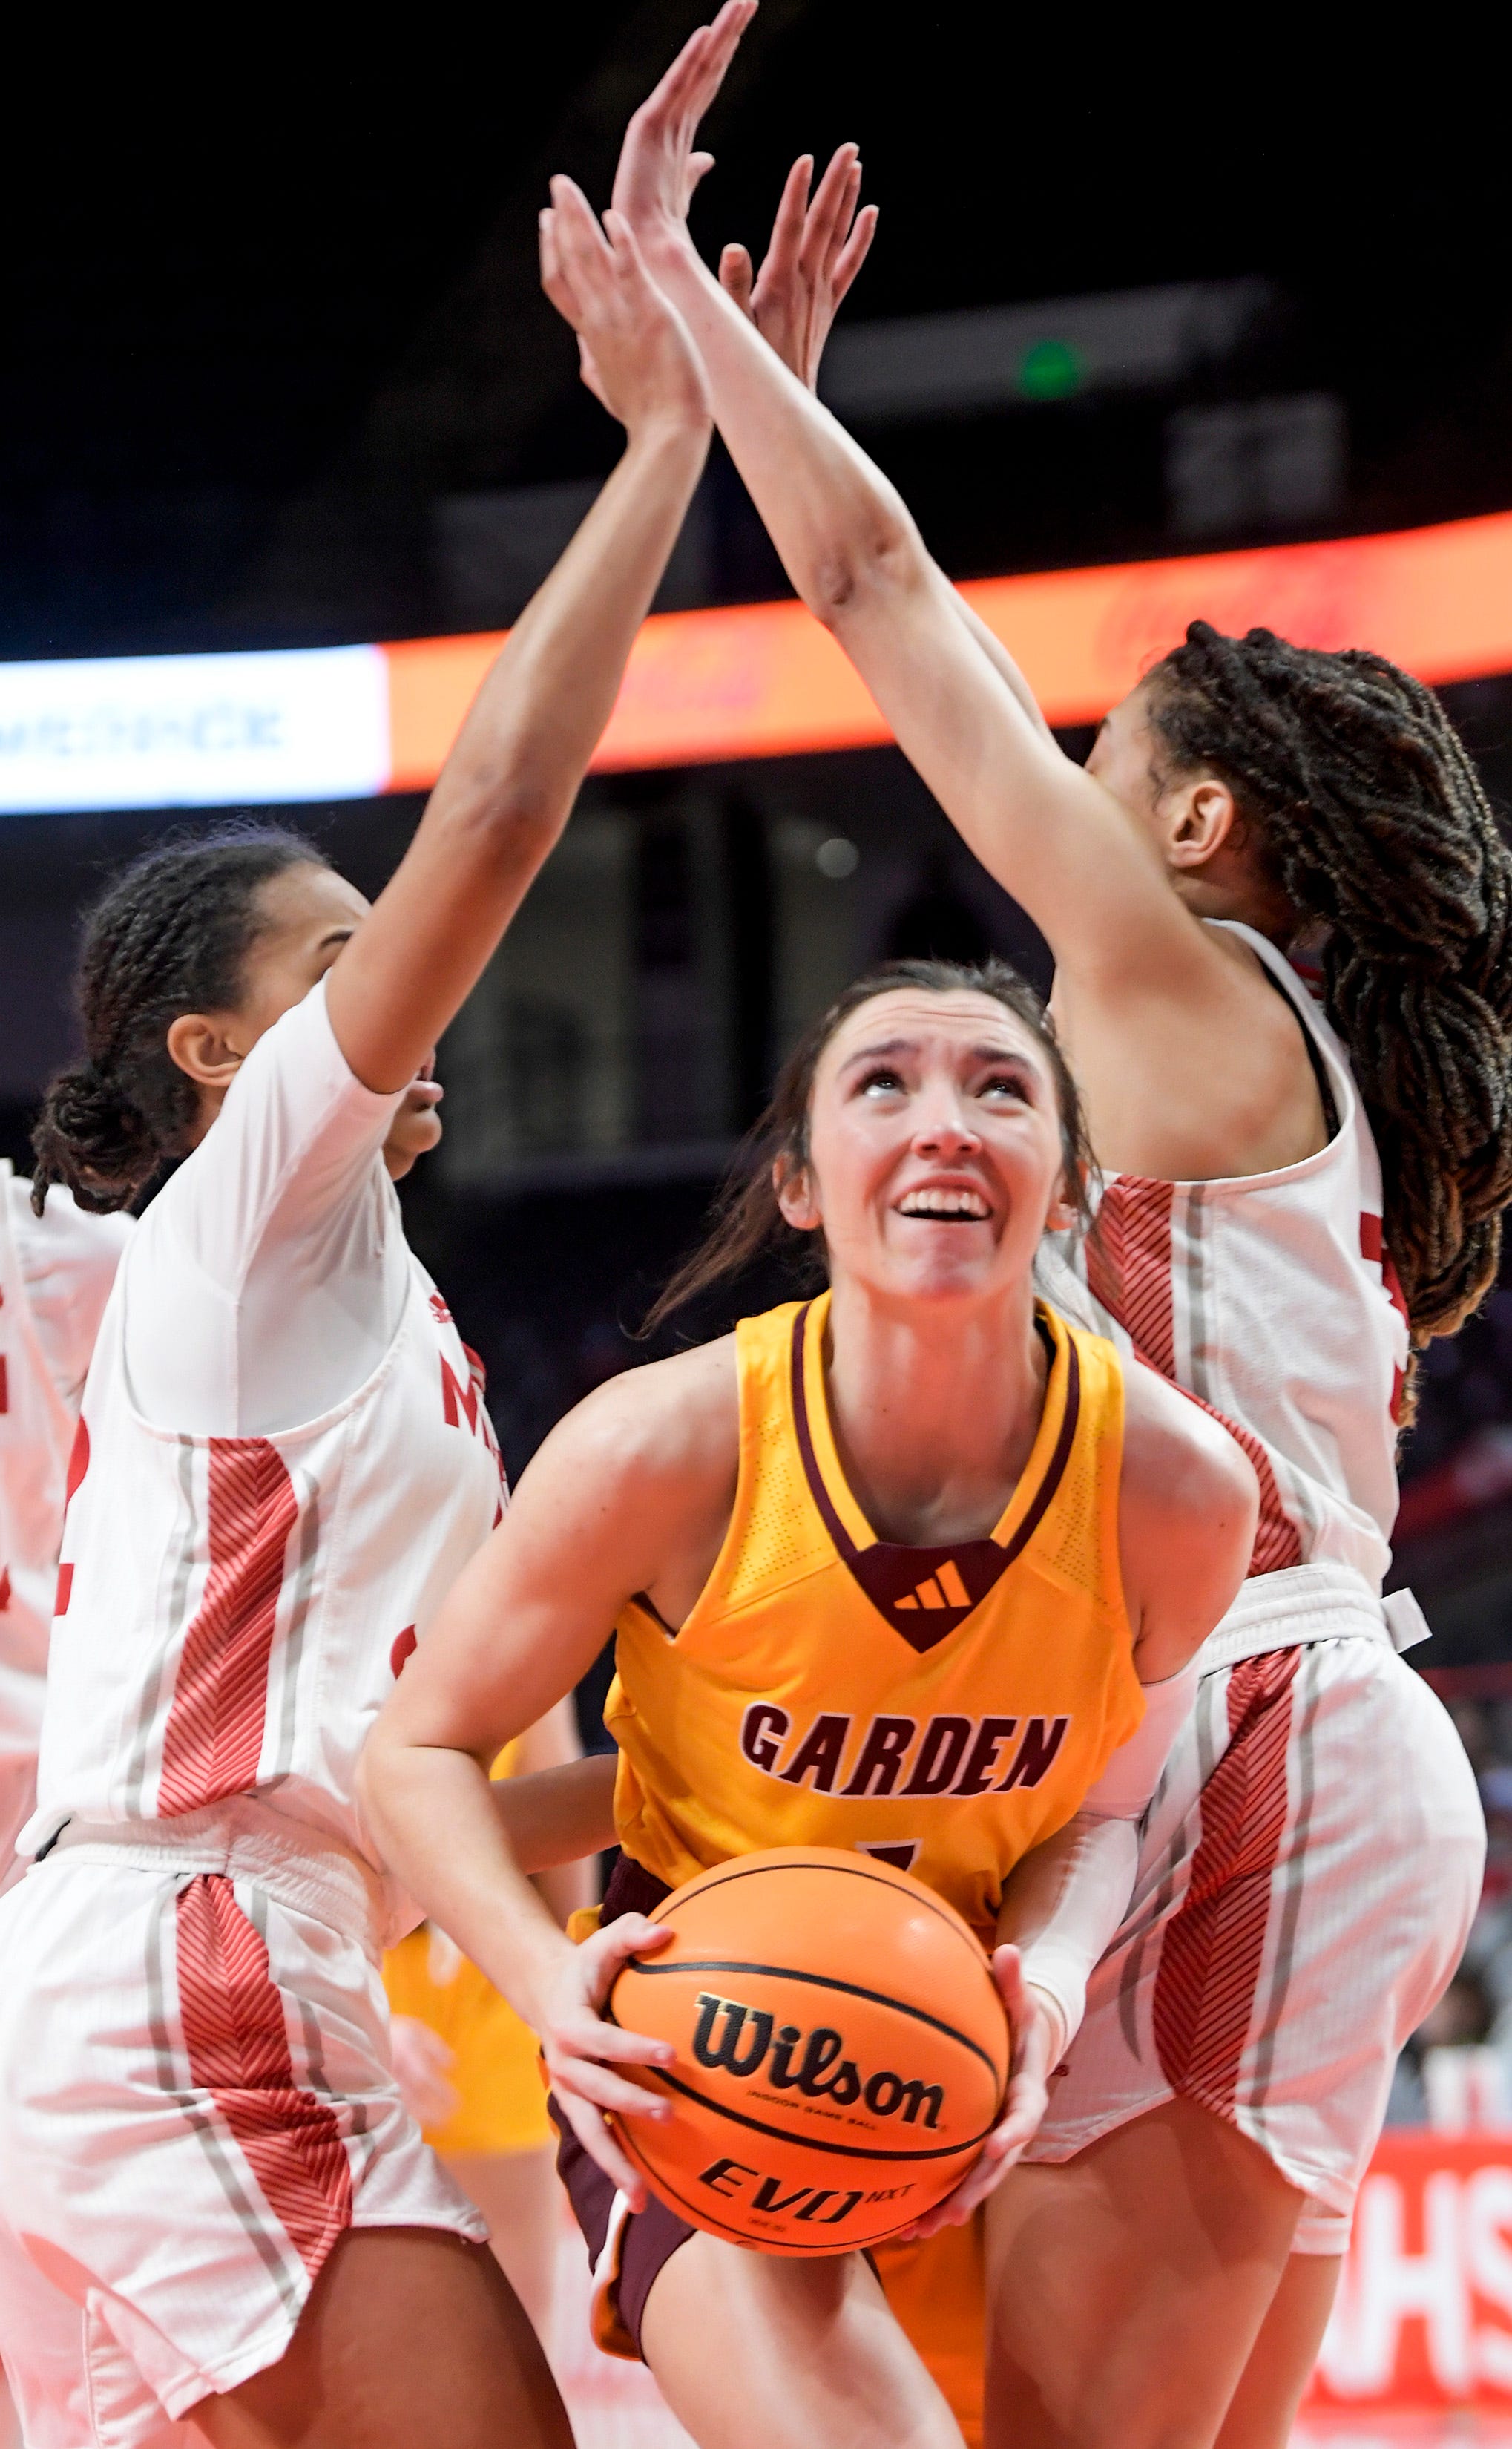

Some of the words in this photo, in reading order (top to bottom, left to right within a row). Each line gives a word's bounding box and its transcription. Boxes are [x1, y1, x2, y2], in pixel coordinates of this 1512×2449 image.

[739, 1700, 1073, 1799] GARDEN
[693, 1991, 944, 2129] Wilson
[699, 2158, 864, 2223] EVO
[865, 2183, 917, 2203] NXT
